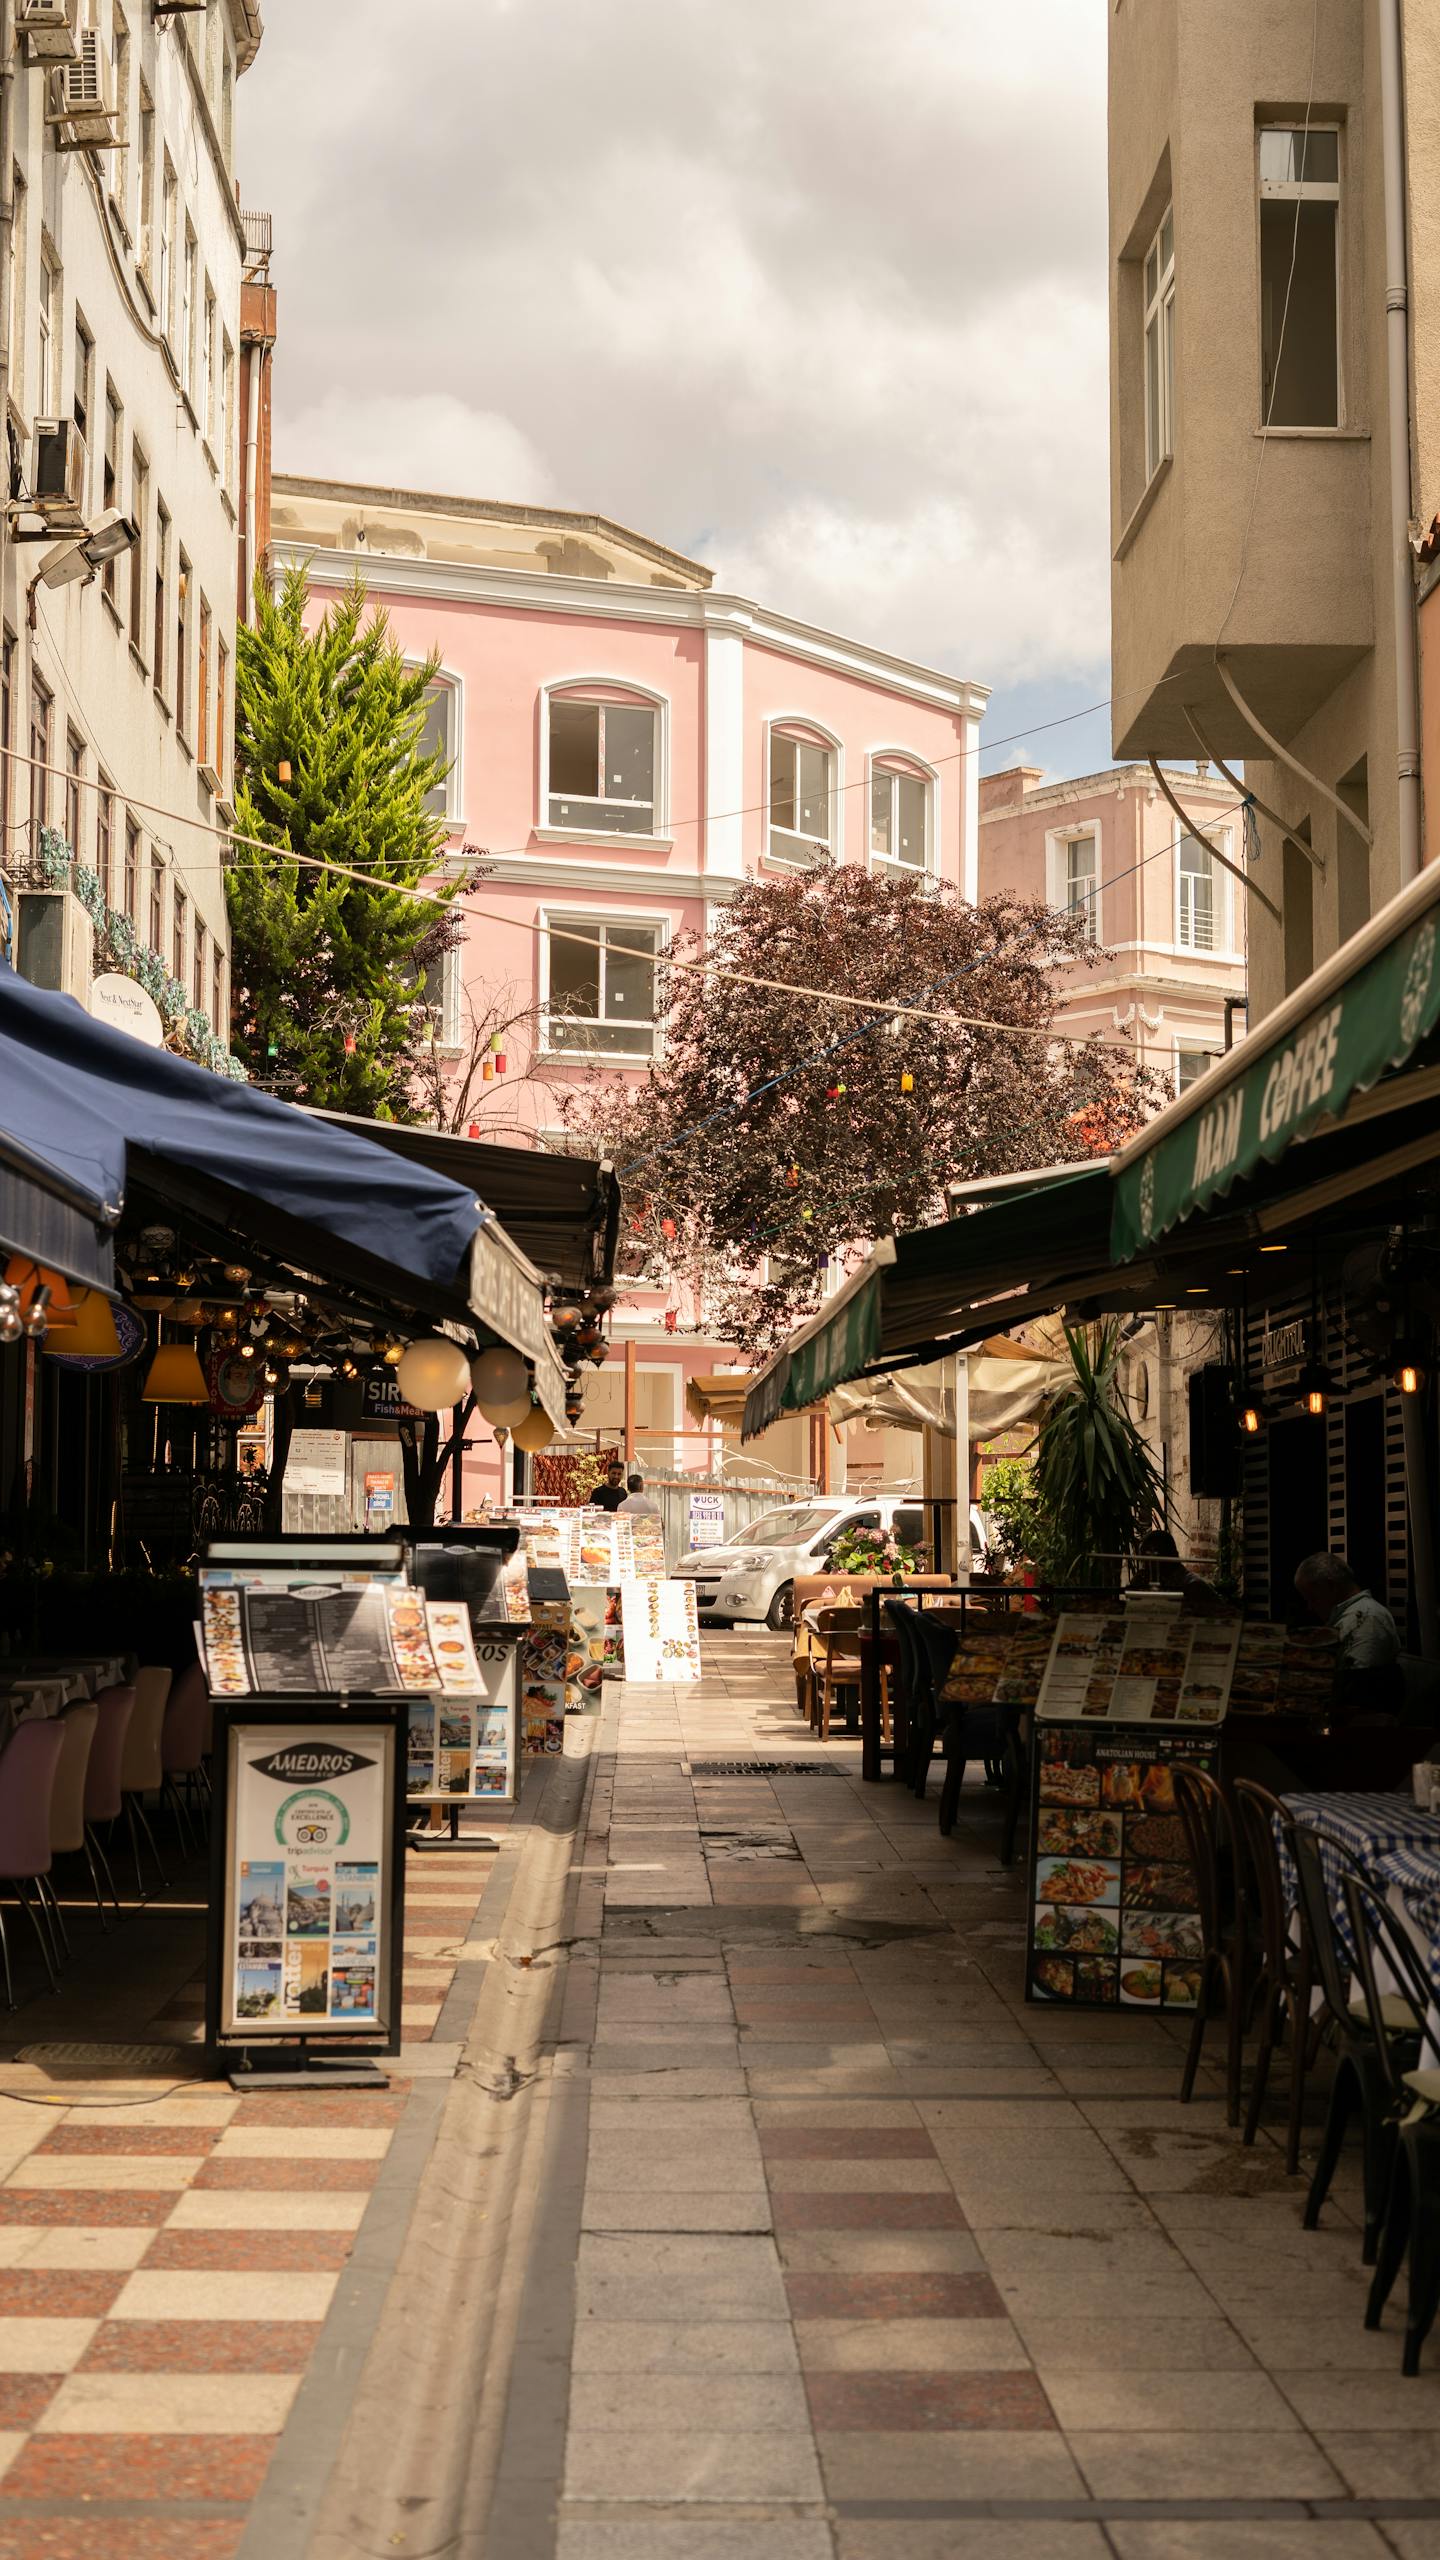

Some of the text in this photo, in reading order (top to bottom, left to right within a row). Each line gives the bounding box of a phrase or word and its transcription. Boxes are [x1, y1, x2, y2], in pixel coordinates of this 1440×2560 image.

[1191, 1004, 1343, 1190] MAN COFFEE
[368, 1382, 406, 1402] SIR
[374, 1403, 425, 1416] Fish&Meat
[268, 1754, 354, 1771] AMEDROS
[1095, 1748, 1157, 1760] ANATOLIAN HOUSE
